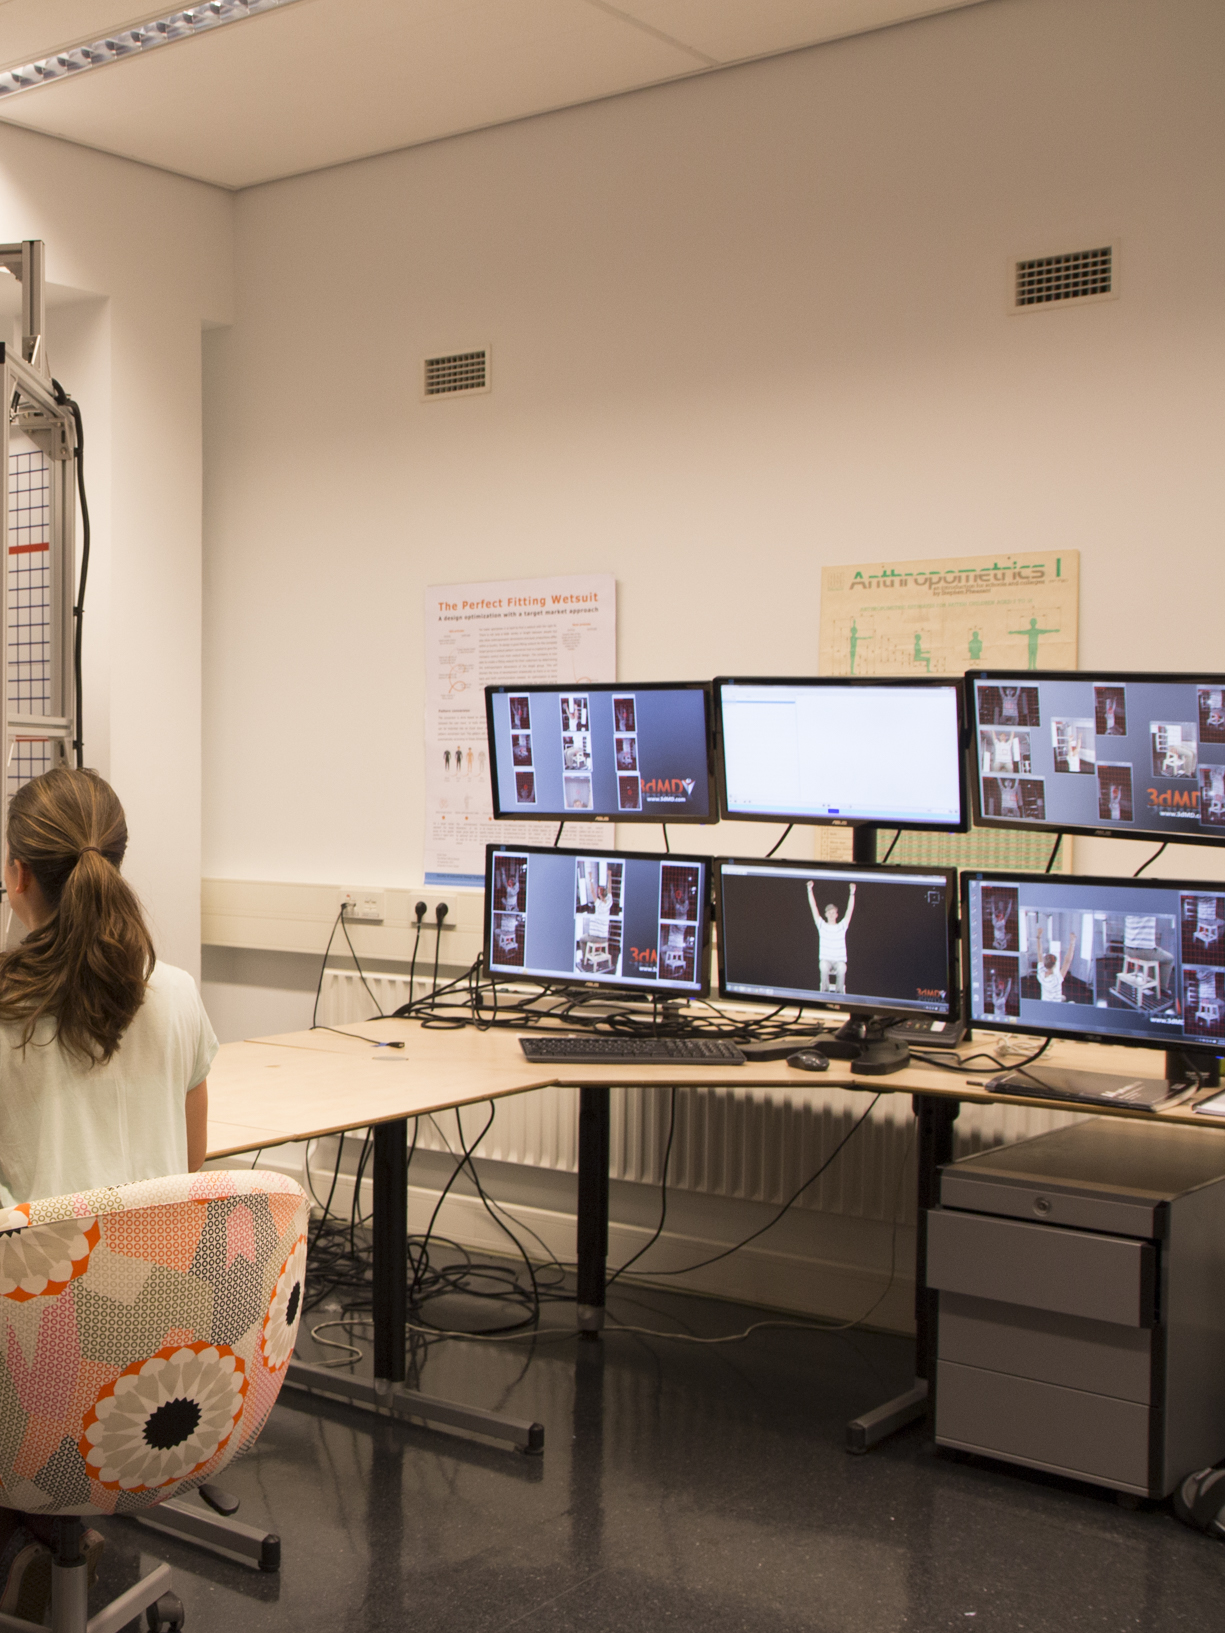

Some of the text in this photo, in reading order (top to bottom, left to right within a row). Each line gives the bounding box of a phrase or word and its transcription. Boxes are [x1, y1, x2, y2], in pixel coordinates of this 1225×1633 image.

[848, 561, 1045, 591] Anthropometrics
[438, 592, 598, 612] The Perfect Fitting Wetsuit
[444, 614, 463, 623] design
[464, 612, 502, 621] optimization
[524, 609, 543, 618] target
[545, 608, 567, 616] market
[569, 606, 599, 615] approach
